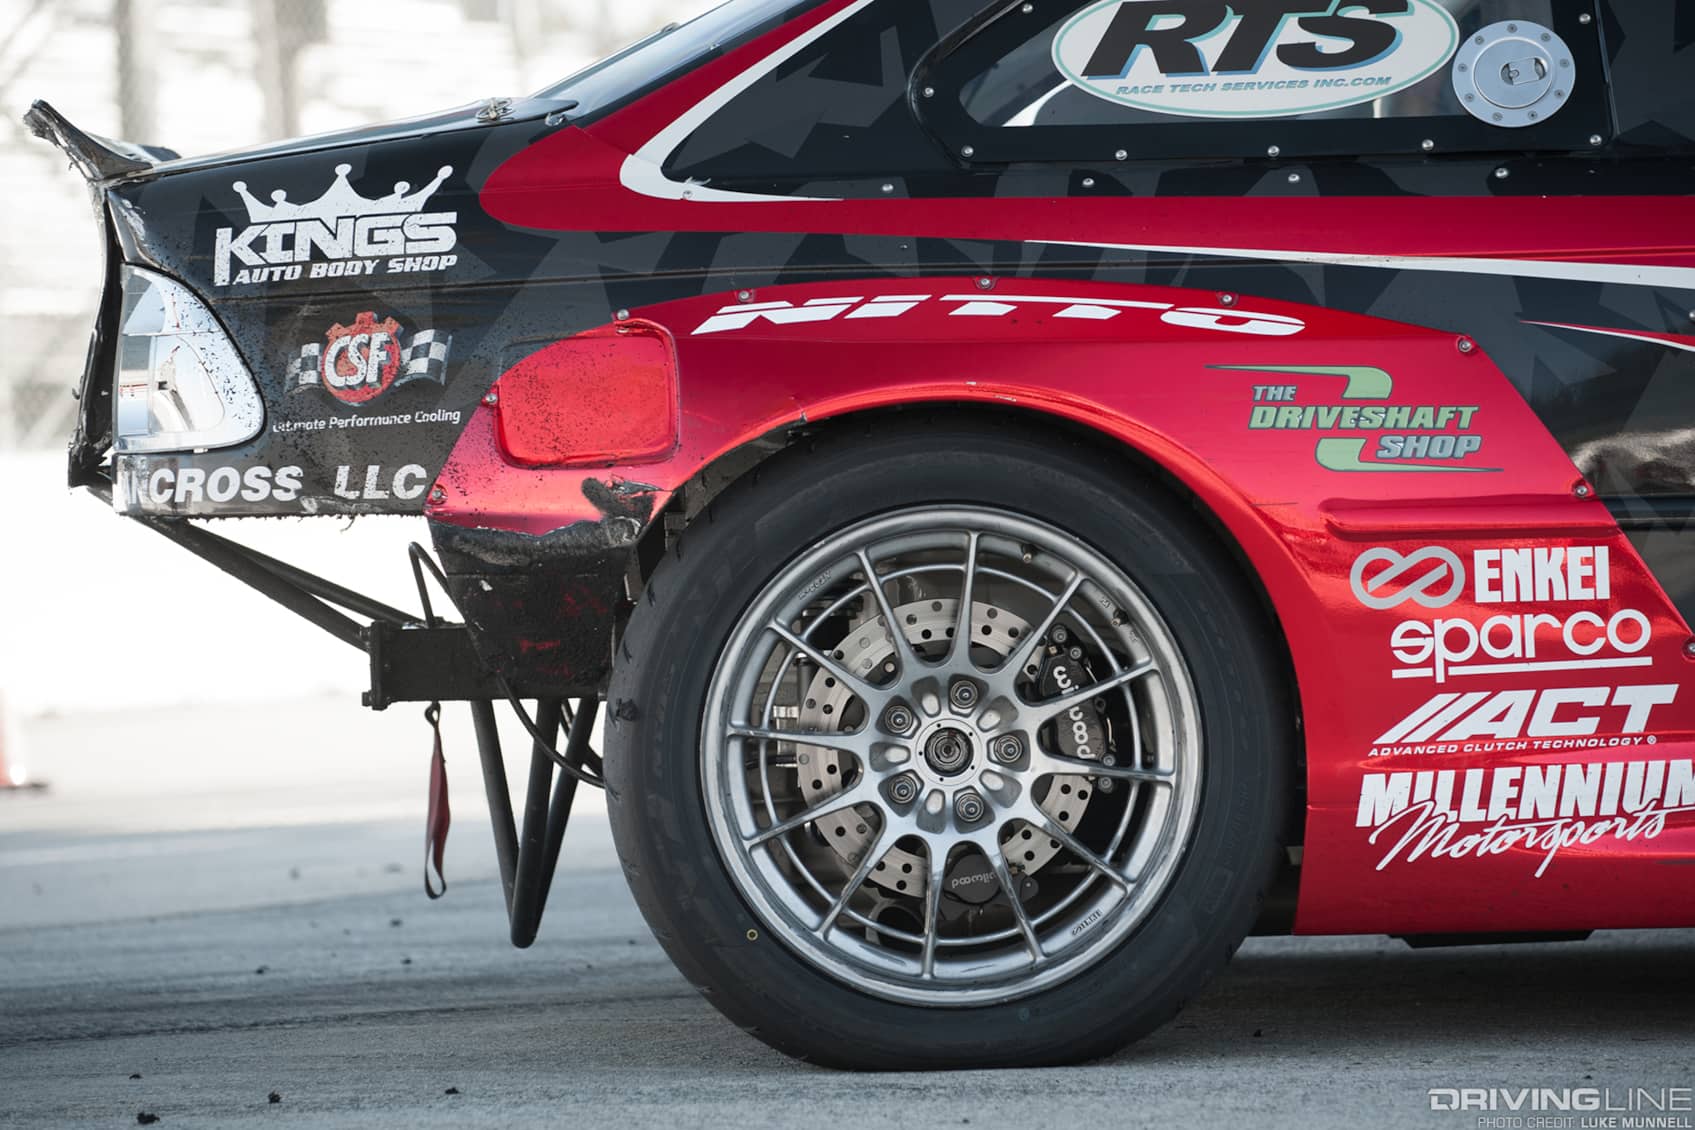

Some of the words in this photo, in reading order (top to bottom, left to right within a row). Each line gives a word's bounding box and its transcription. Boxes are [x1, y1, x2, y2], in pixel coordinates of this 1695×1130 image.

[1080, 0, 1416, 80] RTS
[1115, 85, 1164, 95] RACE
[1170, 83, 1217, 93] TECH
[1221, 79, 1309, 92] SERVICES
[1313, 76, 1392, 88] INC.COM
[214, 211, 457, 286] KINGS
[232, 265, 302, 285] AUTO
[309, 259, 380, 279] BODY
[387, 255, 457, 273] SHOP
[690, 294, 1306, 336] NITTO
[324, 331, 391, 387] CSF
[1252, 385, 1297, 401] THE
[415, 409, 461, 424] Cooling
[1248, 405, 1480, 430] DRIVESHAFT
[1375, 435, 1482, 459] SHOP
[334, 463, 427, 500] LLC
[1473, 545, 1611, 603] ENKEI
[1390, 608, 1652, 683] sparco
[1367, 744, 1458, 757] ADVANCED
[1463, 740, 1527, 753] CLUTCH
[1368, 796, 1667, 878] Motorsports
